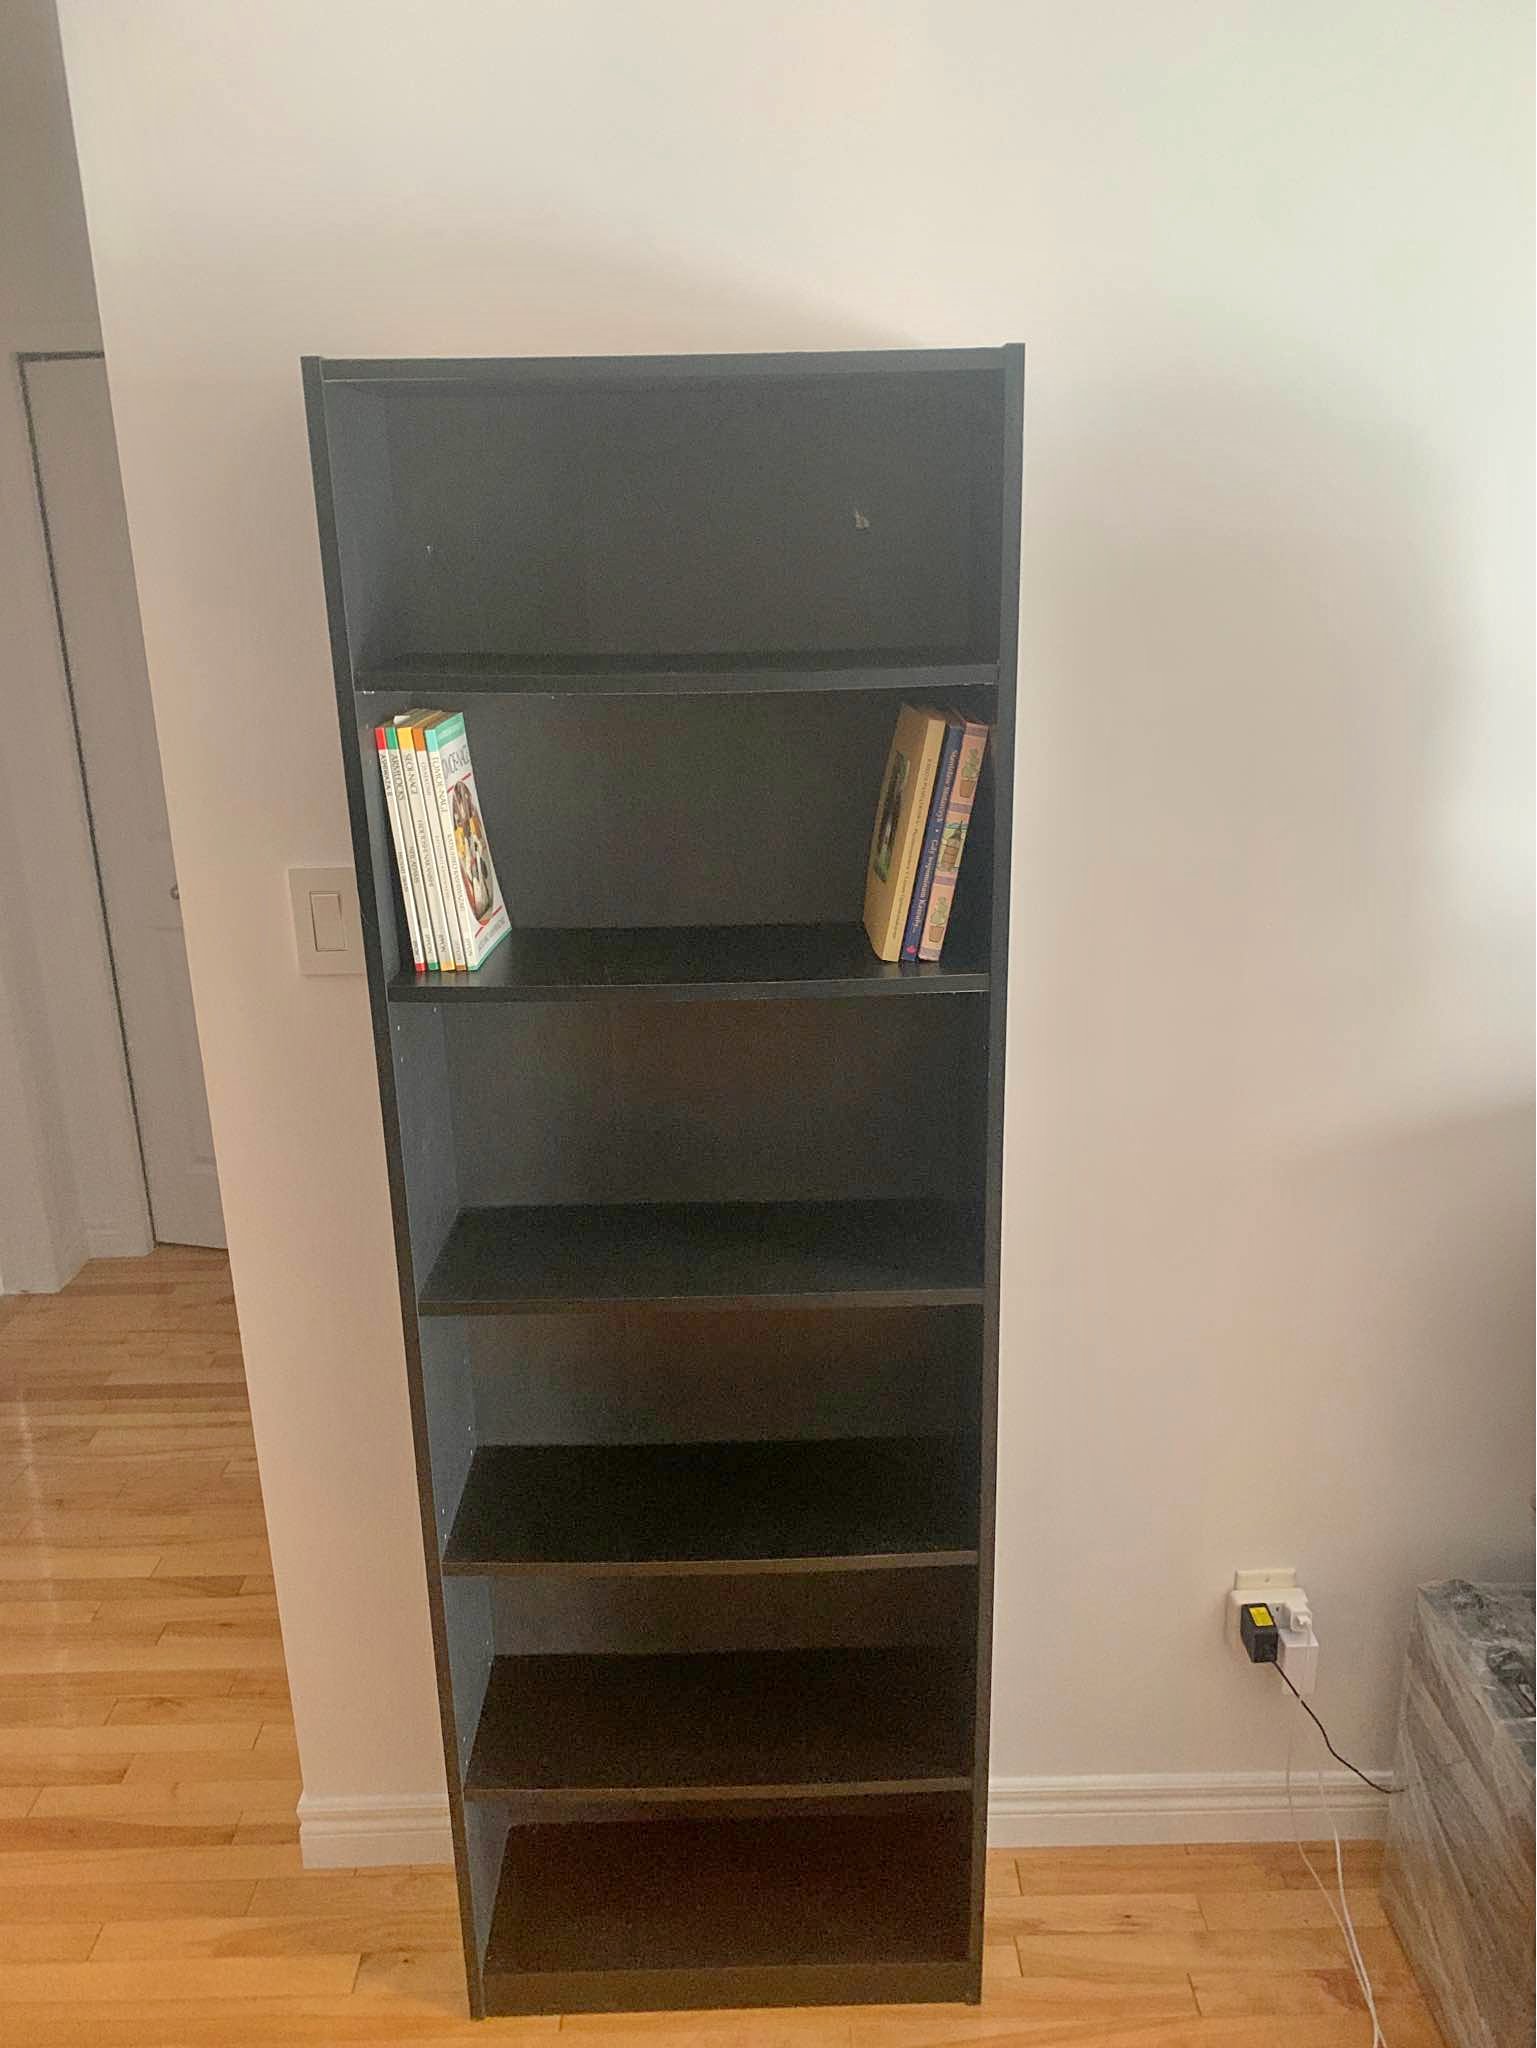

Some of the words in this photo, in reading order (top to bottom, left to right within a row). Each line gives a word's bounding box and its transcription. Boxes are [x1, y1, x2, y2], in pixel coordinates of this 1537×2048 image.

[390, 753, 405, 801] ARMLOCKS
[403, 752, 418, 795] SEOI-NAGE
[431, 756, 448, 813] TOMOE-NAGE
